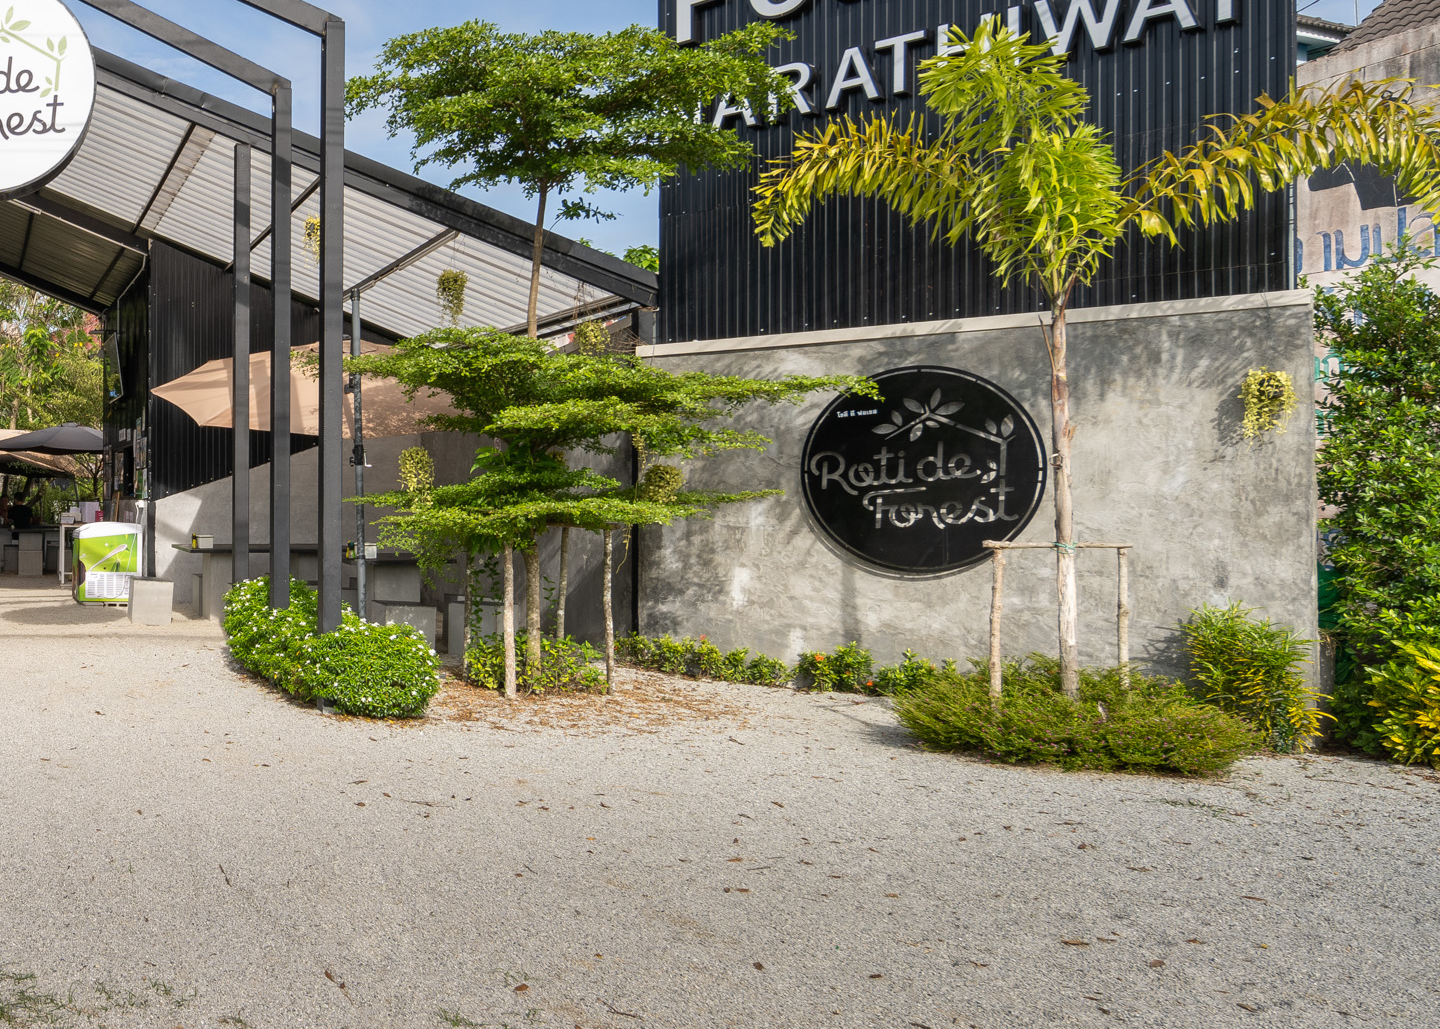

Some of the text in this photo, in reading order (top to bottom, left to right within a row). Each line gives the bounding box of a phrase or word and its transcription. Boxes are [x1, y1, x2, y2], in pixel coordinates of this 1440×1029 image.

[810, 441, 981, 496] Roti de
[863, 479, 1019, 529] Forest
